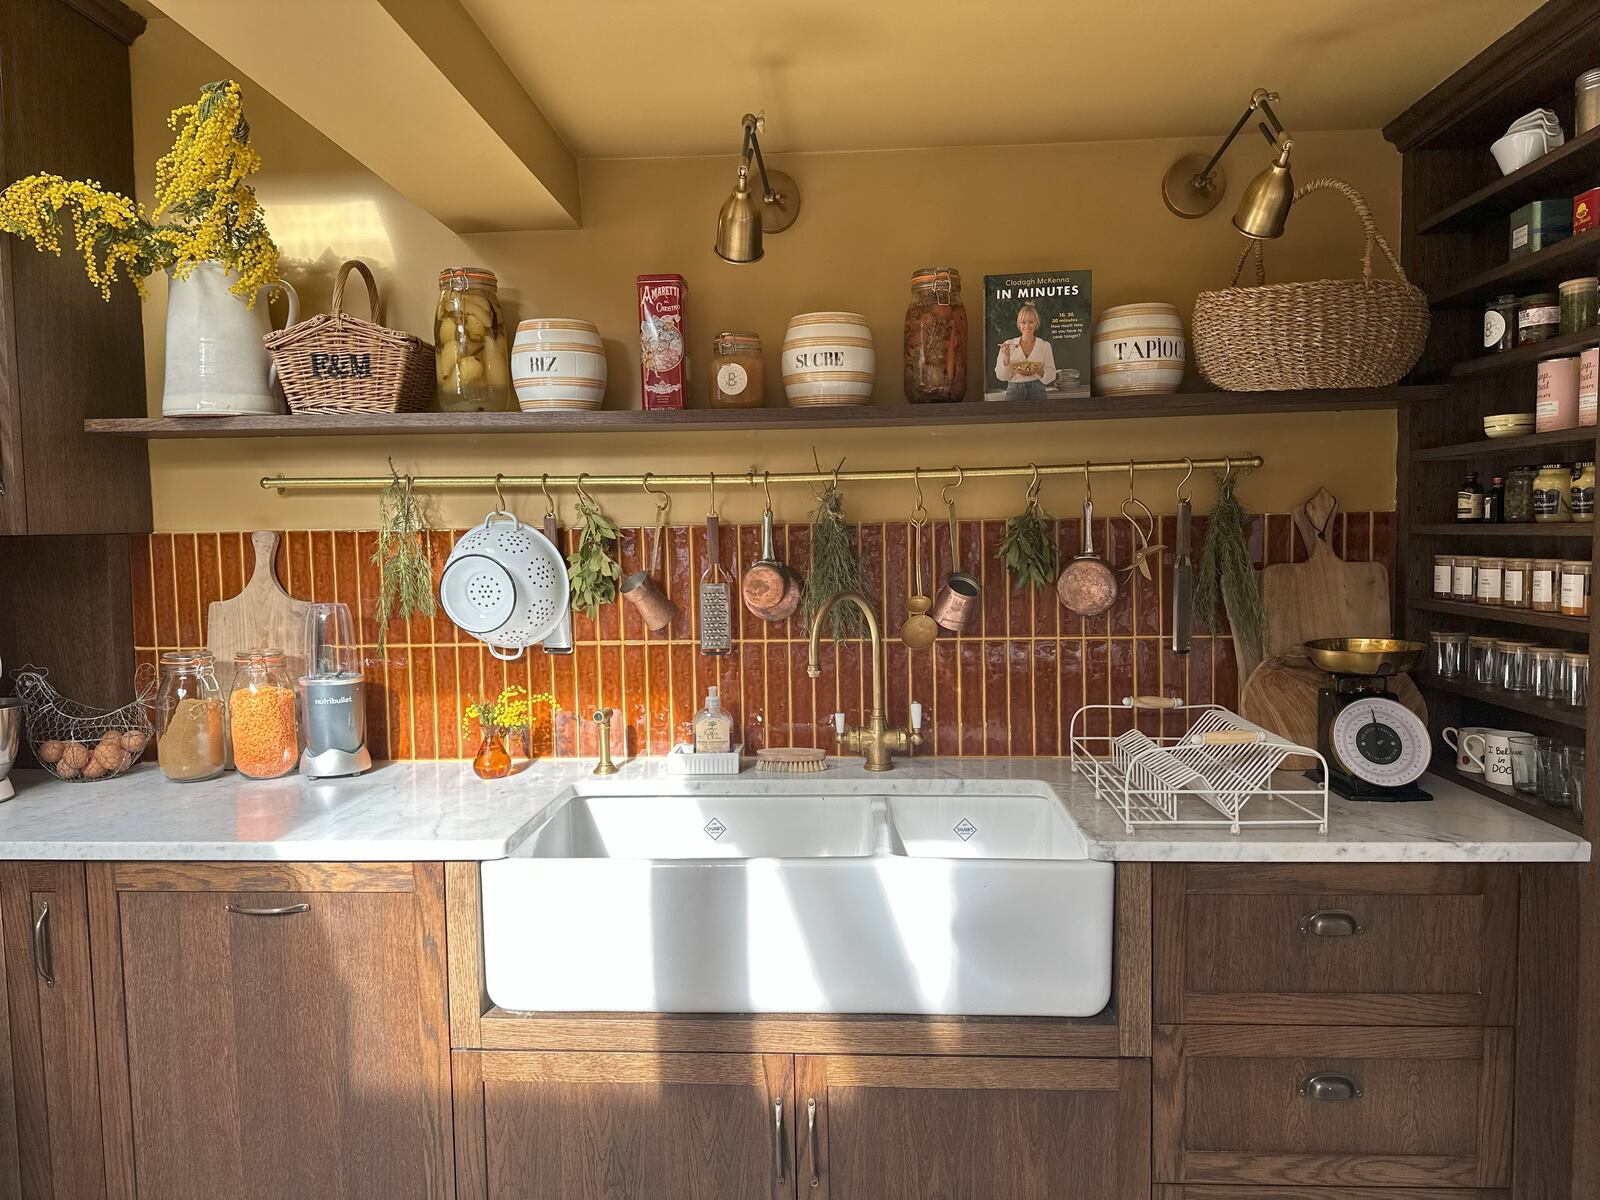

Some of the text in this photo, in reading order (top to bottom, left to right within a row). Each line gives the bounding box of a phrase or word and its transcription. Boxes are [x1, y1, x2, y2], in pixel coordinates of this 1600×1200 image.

[1005, 277, 1070, 287] Clodagh McKenna
[996, 285, 1079, 300] IN MINUTES
[1114, 337, 1184, 361] TAPIOC
[796, 351, 844, 369] SUCRE
[314, 696, 352, 705] nutribullet
[1488, 745, 1493, 754] I
